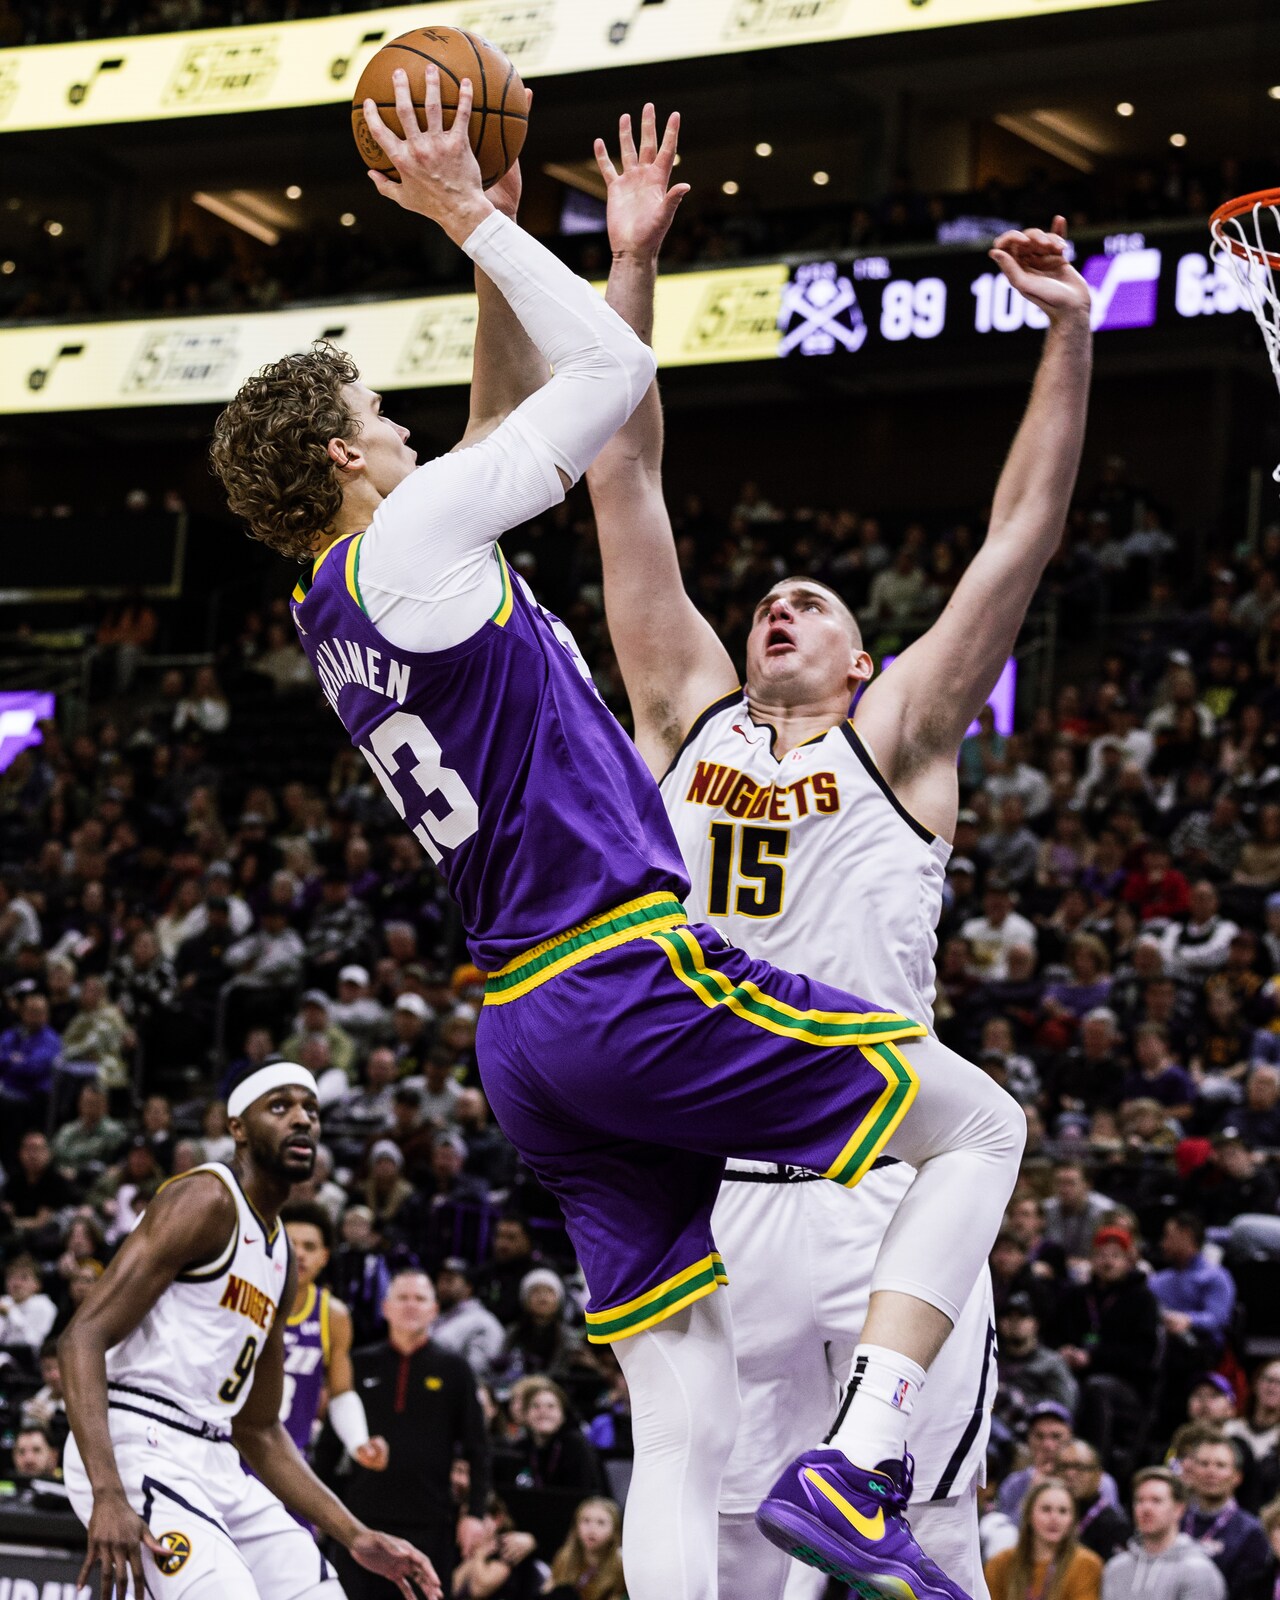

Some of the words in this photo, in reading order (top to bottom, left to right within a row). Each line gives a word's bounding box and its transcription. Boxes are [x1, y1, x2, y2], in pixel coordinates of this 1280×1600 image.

[879, 277, 946, 341] 89
[707, 820, 790, 919] 15
[218, 1335, 257, 1403] 9
